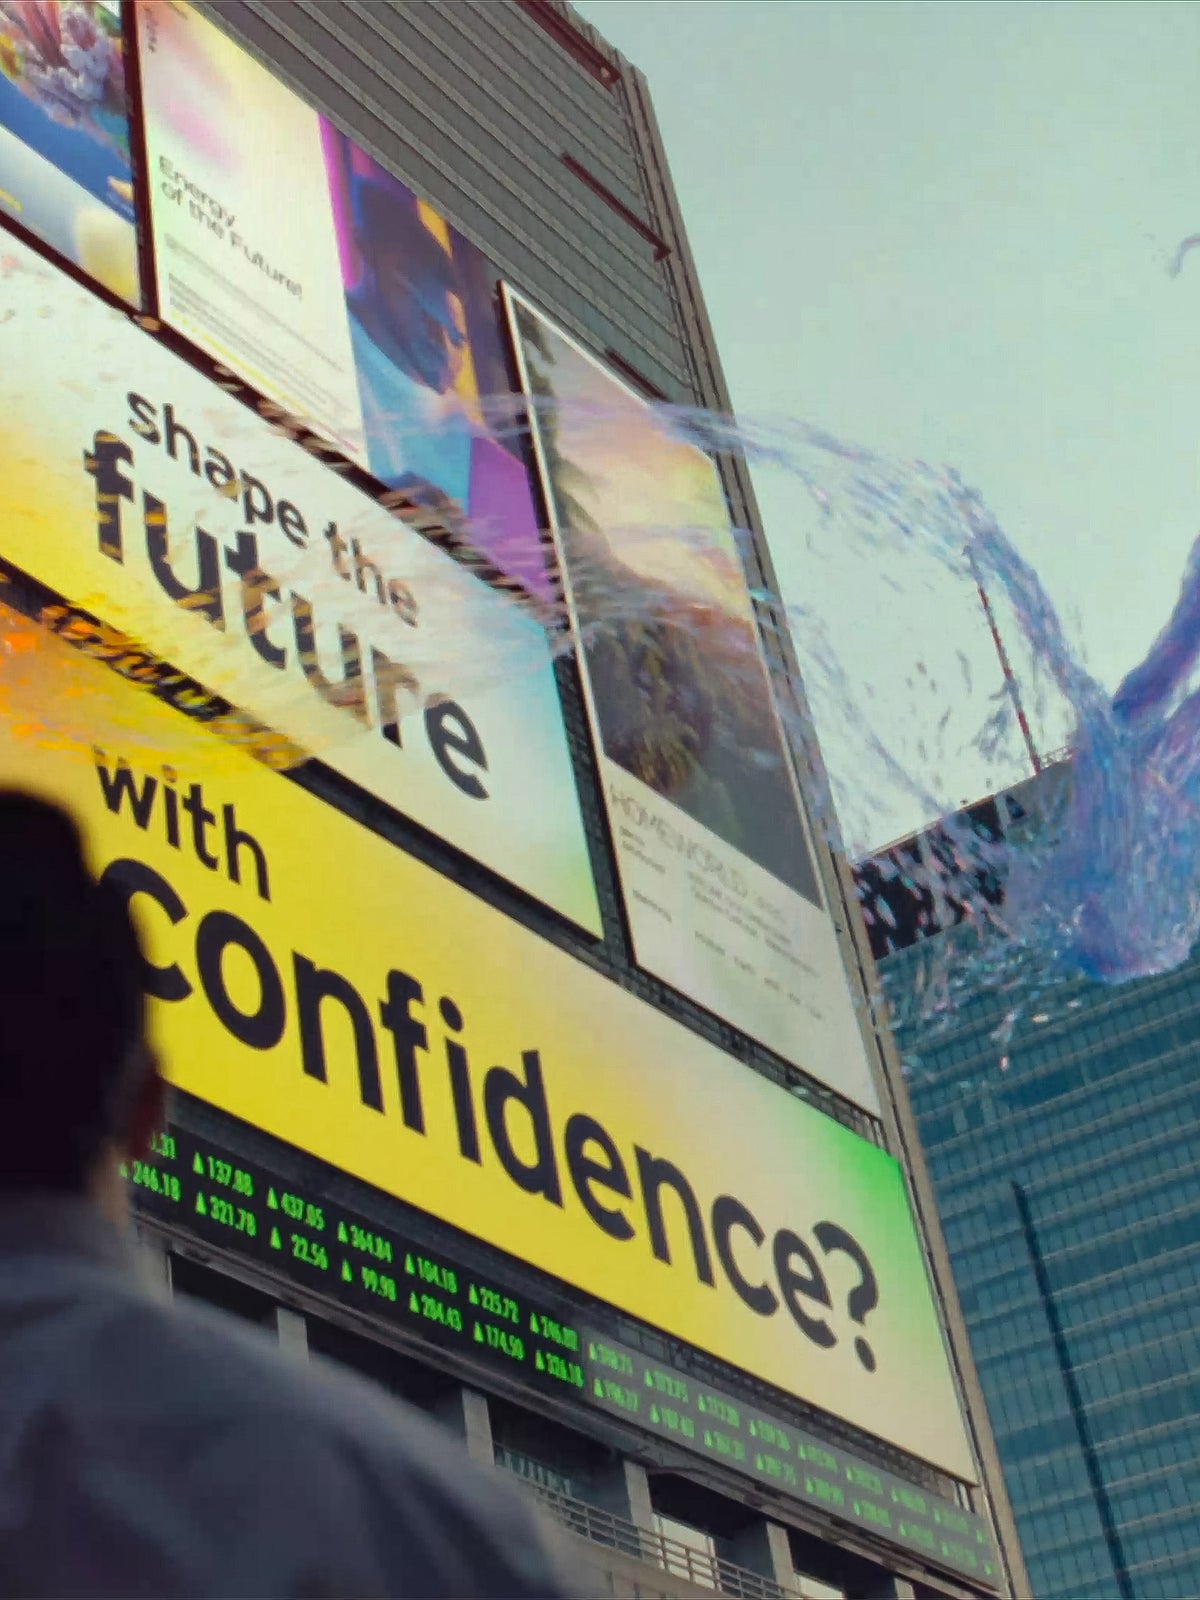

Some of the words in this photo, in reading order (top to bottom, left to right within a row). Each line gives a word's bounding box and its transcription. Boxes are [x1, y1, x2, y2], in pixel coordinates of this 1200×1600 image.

[83, 429, 490, 801] future
[126, 390, 310, 550] shape
[323, 520, 419, 629] the
[93, 744, 272, 903] with
[98, 855, 879, 1374] confidence?
